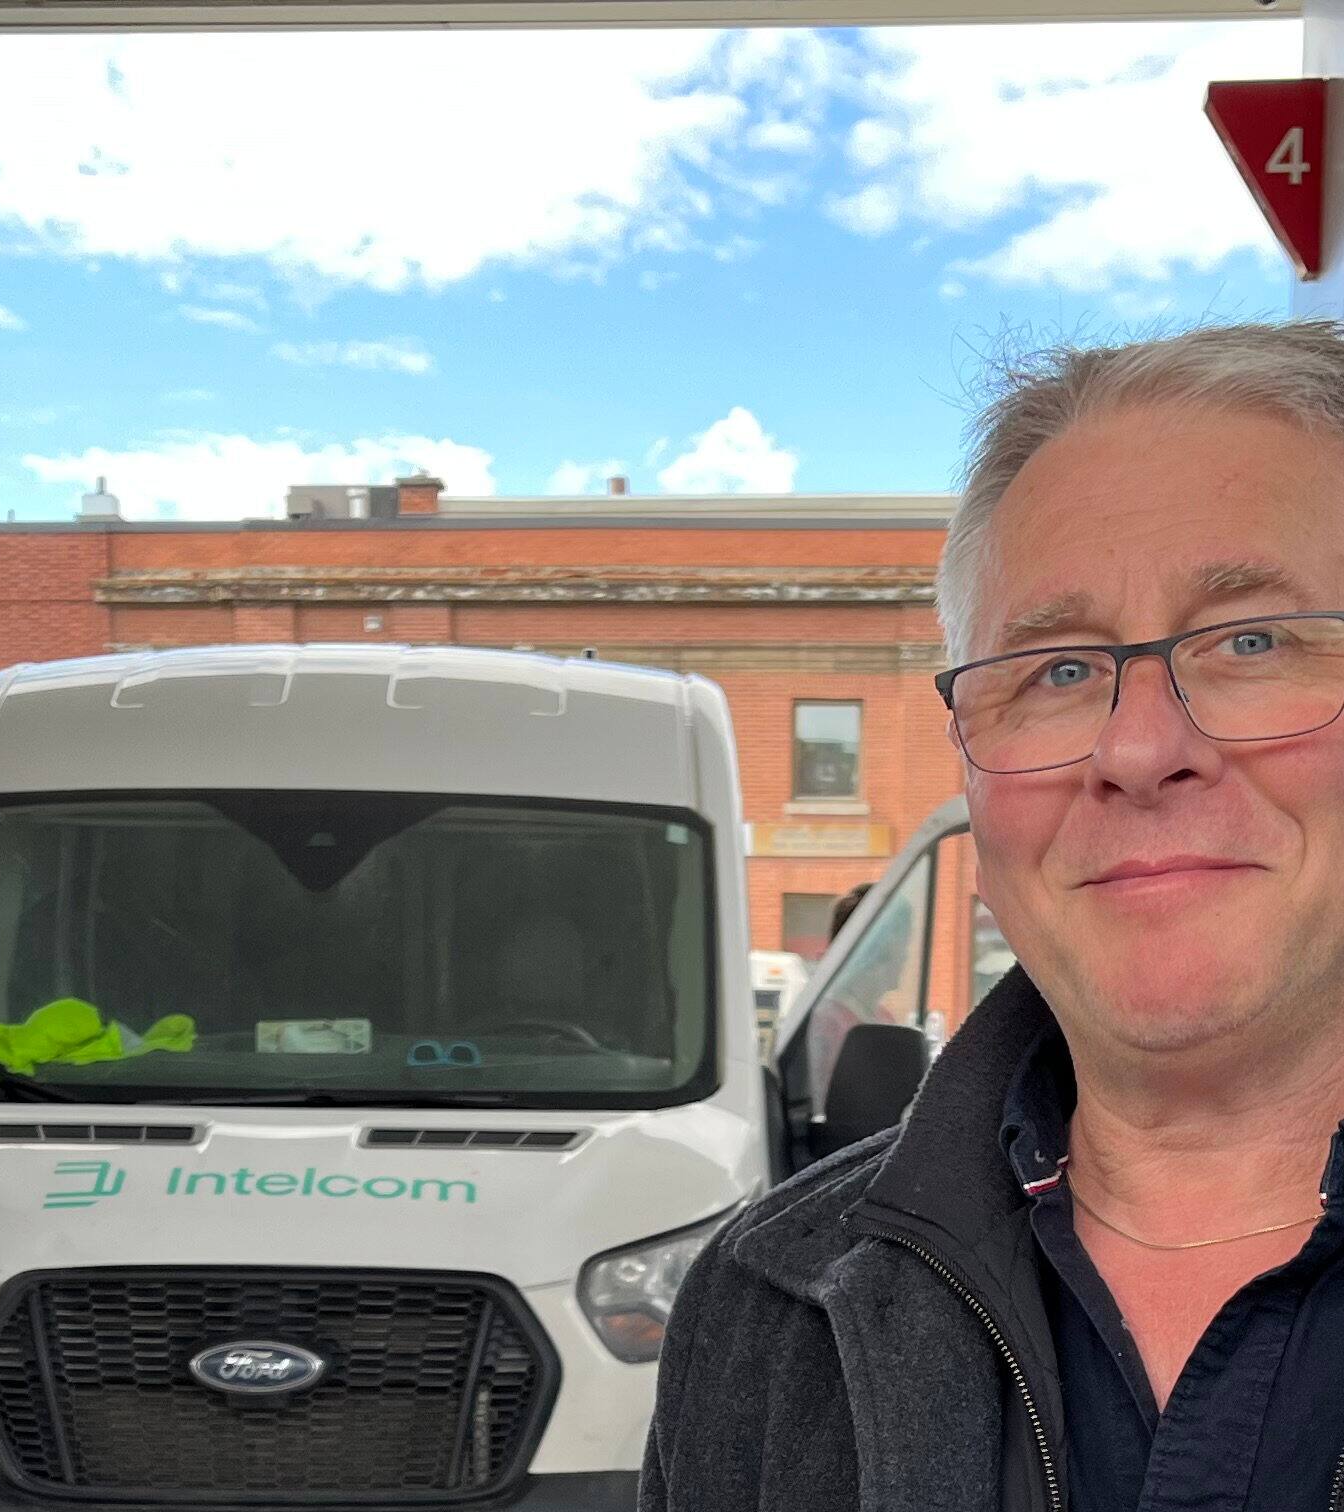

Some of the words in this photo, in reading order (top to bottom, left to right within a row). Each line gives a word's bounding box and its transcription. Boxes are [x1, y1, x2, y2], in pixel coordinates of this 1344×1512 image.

[1265, 127, 1311, 185] 4
[165, 1166, 478, 1204] Intelcom
[219, 1350, 293, 1380] Ford
